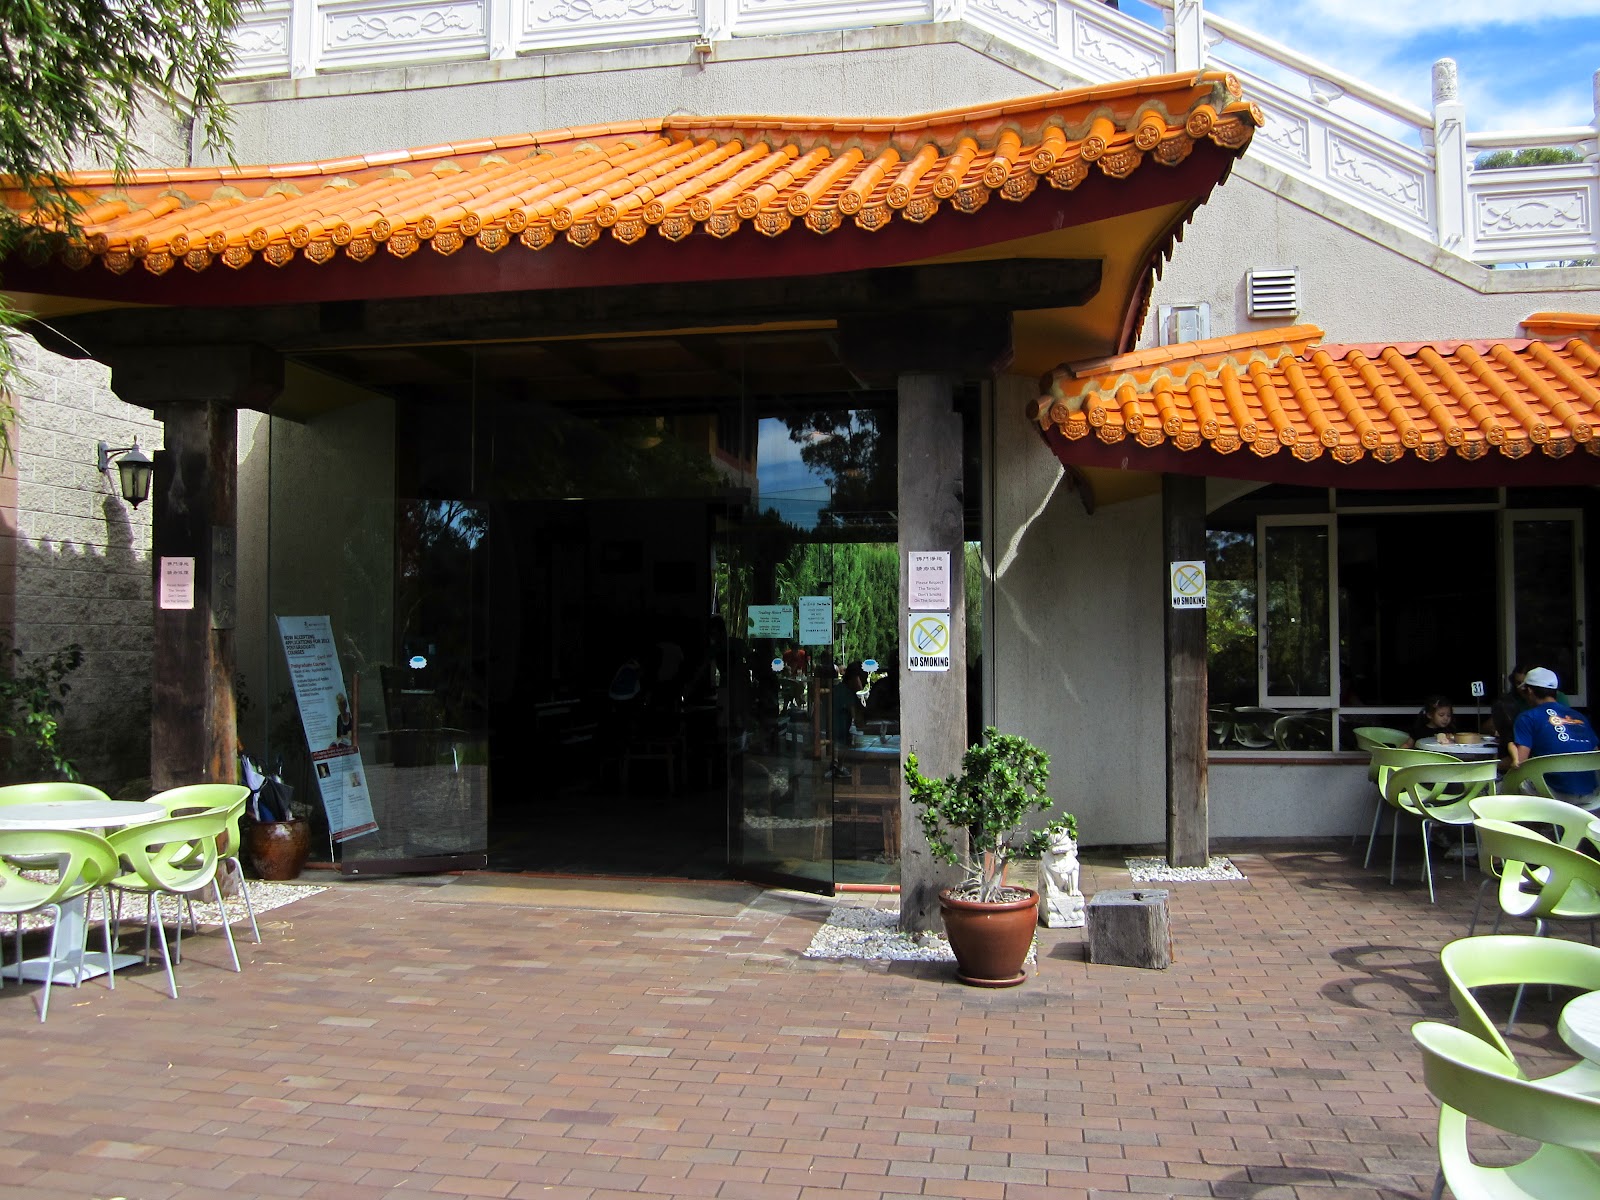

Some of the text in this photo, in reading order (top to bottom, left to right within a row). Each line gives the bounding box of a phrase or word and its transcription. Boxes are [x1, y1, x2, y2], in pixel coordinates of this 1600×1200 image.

[1173, 596, 1205, 605] NO SMOKING
[910, 657, 948, 666] NO SMOKING
[1473, 683, 1482, 694] 31
